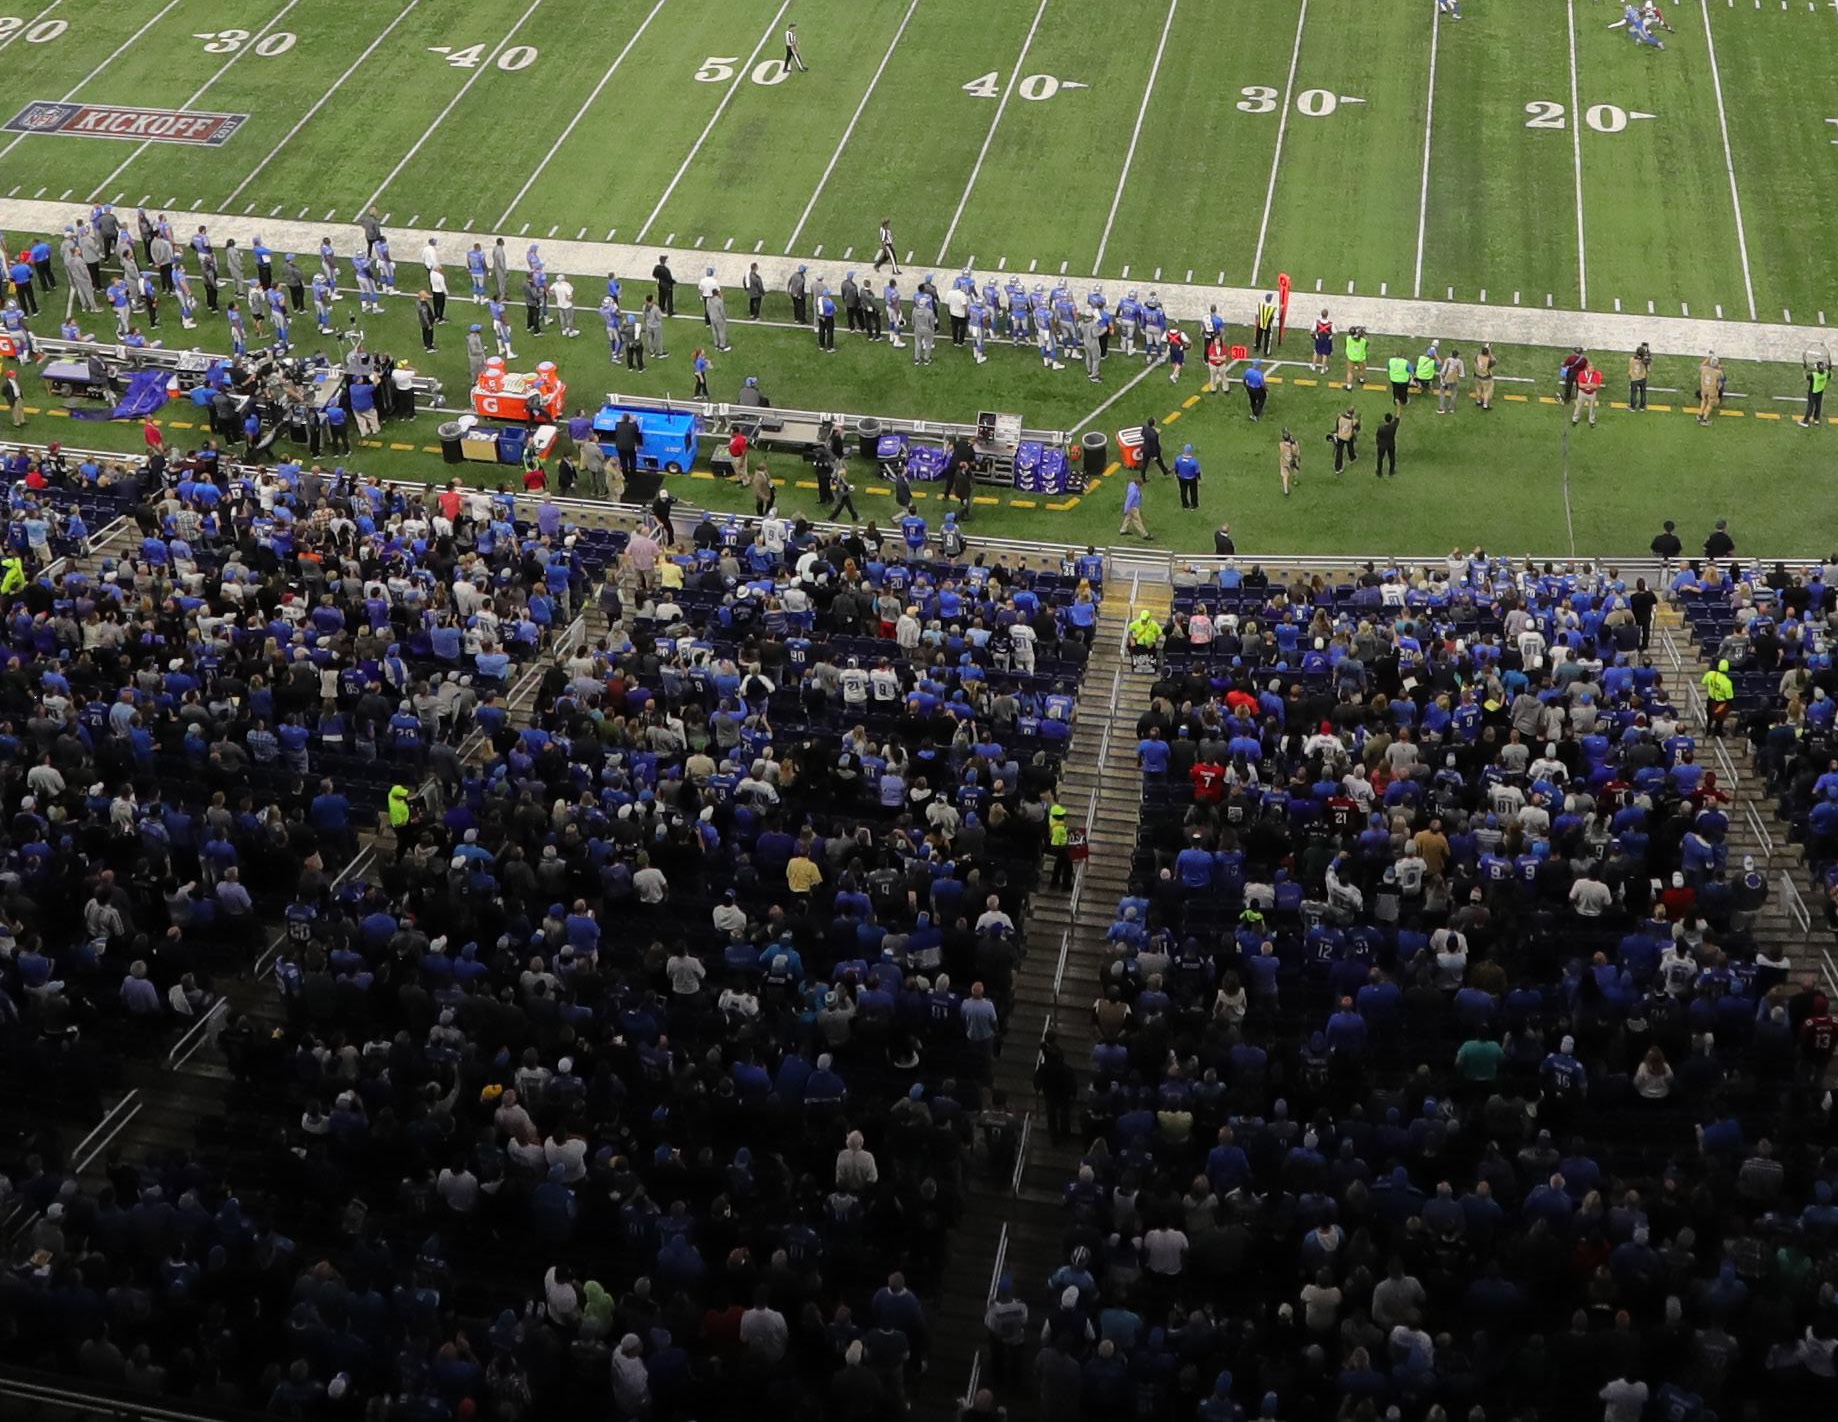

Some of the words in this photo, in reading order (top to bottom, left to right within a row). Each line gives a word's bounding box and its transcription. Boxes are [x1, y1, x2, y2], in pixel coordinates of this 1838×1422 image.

[203, 28, 298, 58] 30
[440, 43, 539, 72] 40
[694, 57, 790, 86] 50
[962, 71, 1060, 102] 40
[1236, 85, 1340, 117] 30
[74, 111, 214, 137] KICKOFF
[1524, 100, 1630, 133] 20
[1231, 346, 1246, 359] 30
[482, 397, 499, 413] G
